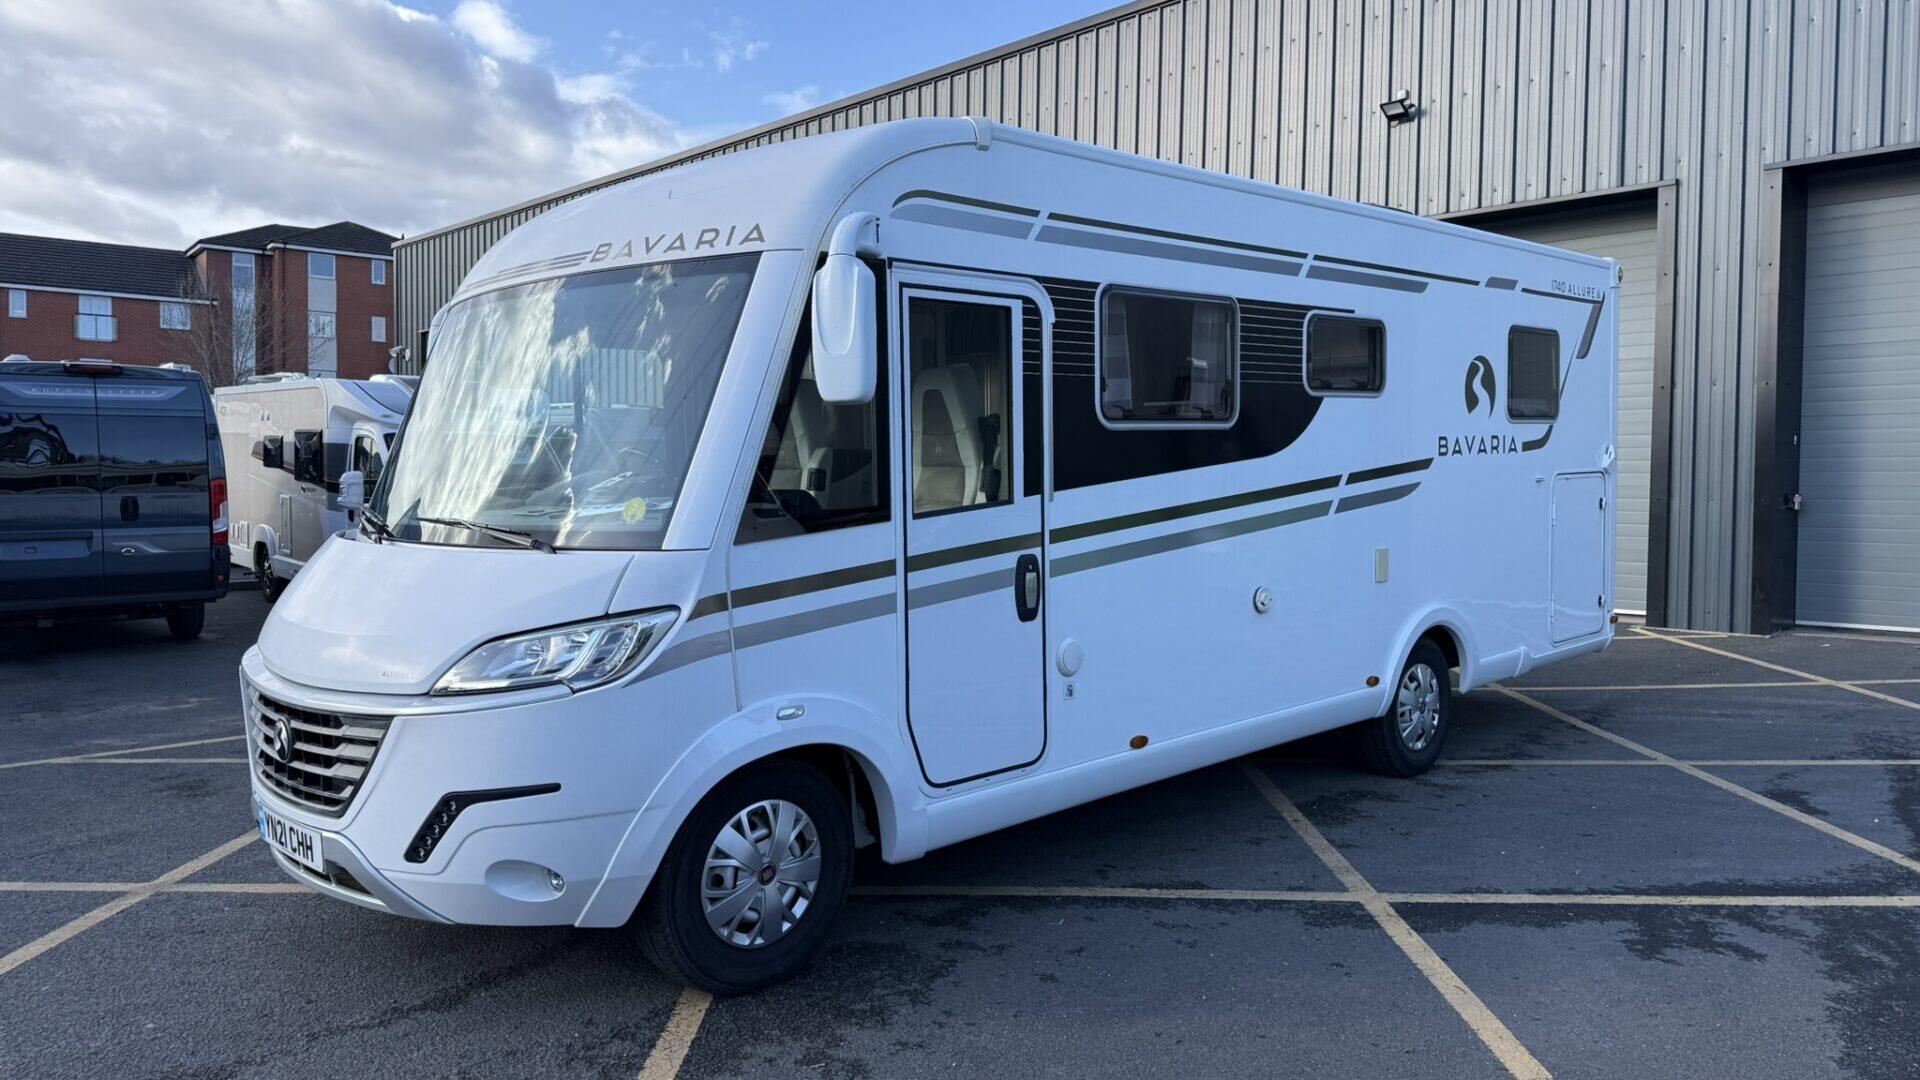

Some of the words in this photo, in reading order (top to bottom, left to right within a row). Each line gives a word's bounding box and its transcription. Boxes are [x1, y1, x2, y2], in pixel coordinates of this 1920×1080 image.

[589, 222, 766, 263] BAVARIA
[1568, 283, 1596, 299] ALLURE
[1438, 435, 1518, 456] BAVARIA
[264, 811, 288, 849] YN21
[289, 826, 314, 863] CHH
